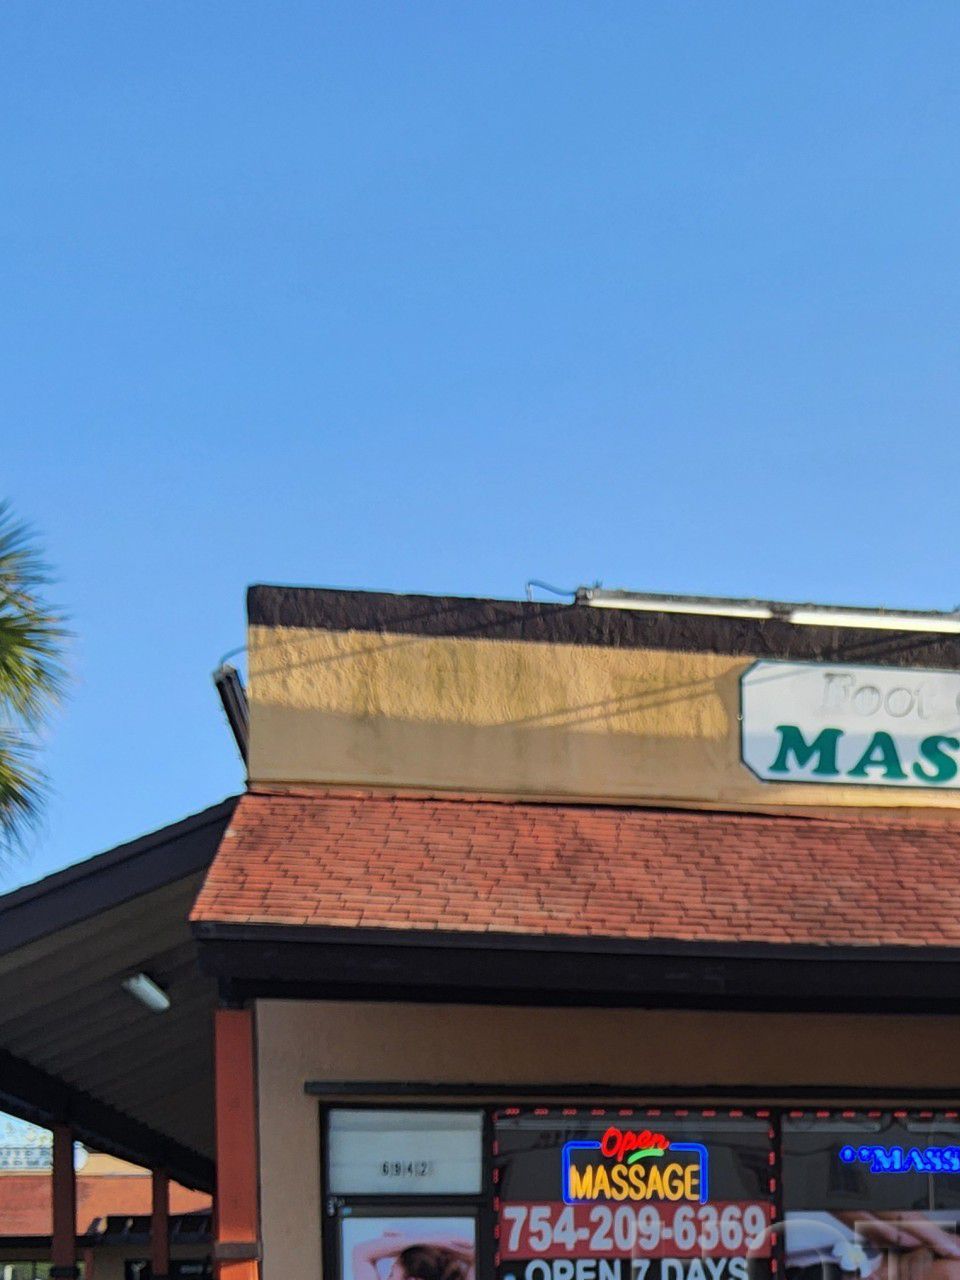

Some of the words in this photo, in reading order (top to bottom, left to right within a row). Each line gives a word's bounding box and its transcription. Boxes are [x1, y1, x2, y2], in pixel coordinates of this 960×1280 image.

[601, 1126, 671, 1162] Open
[569, 1163, 700, 1201] MASSAGE
[503, 1204, 766, 1253] 754-209-6369
